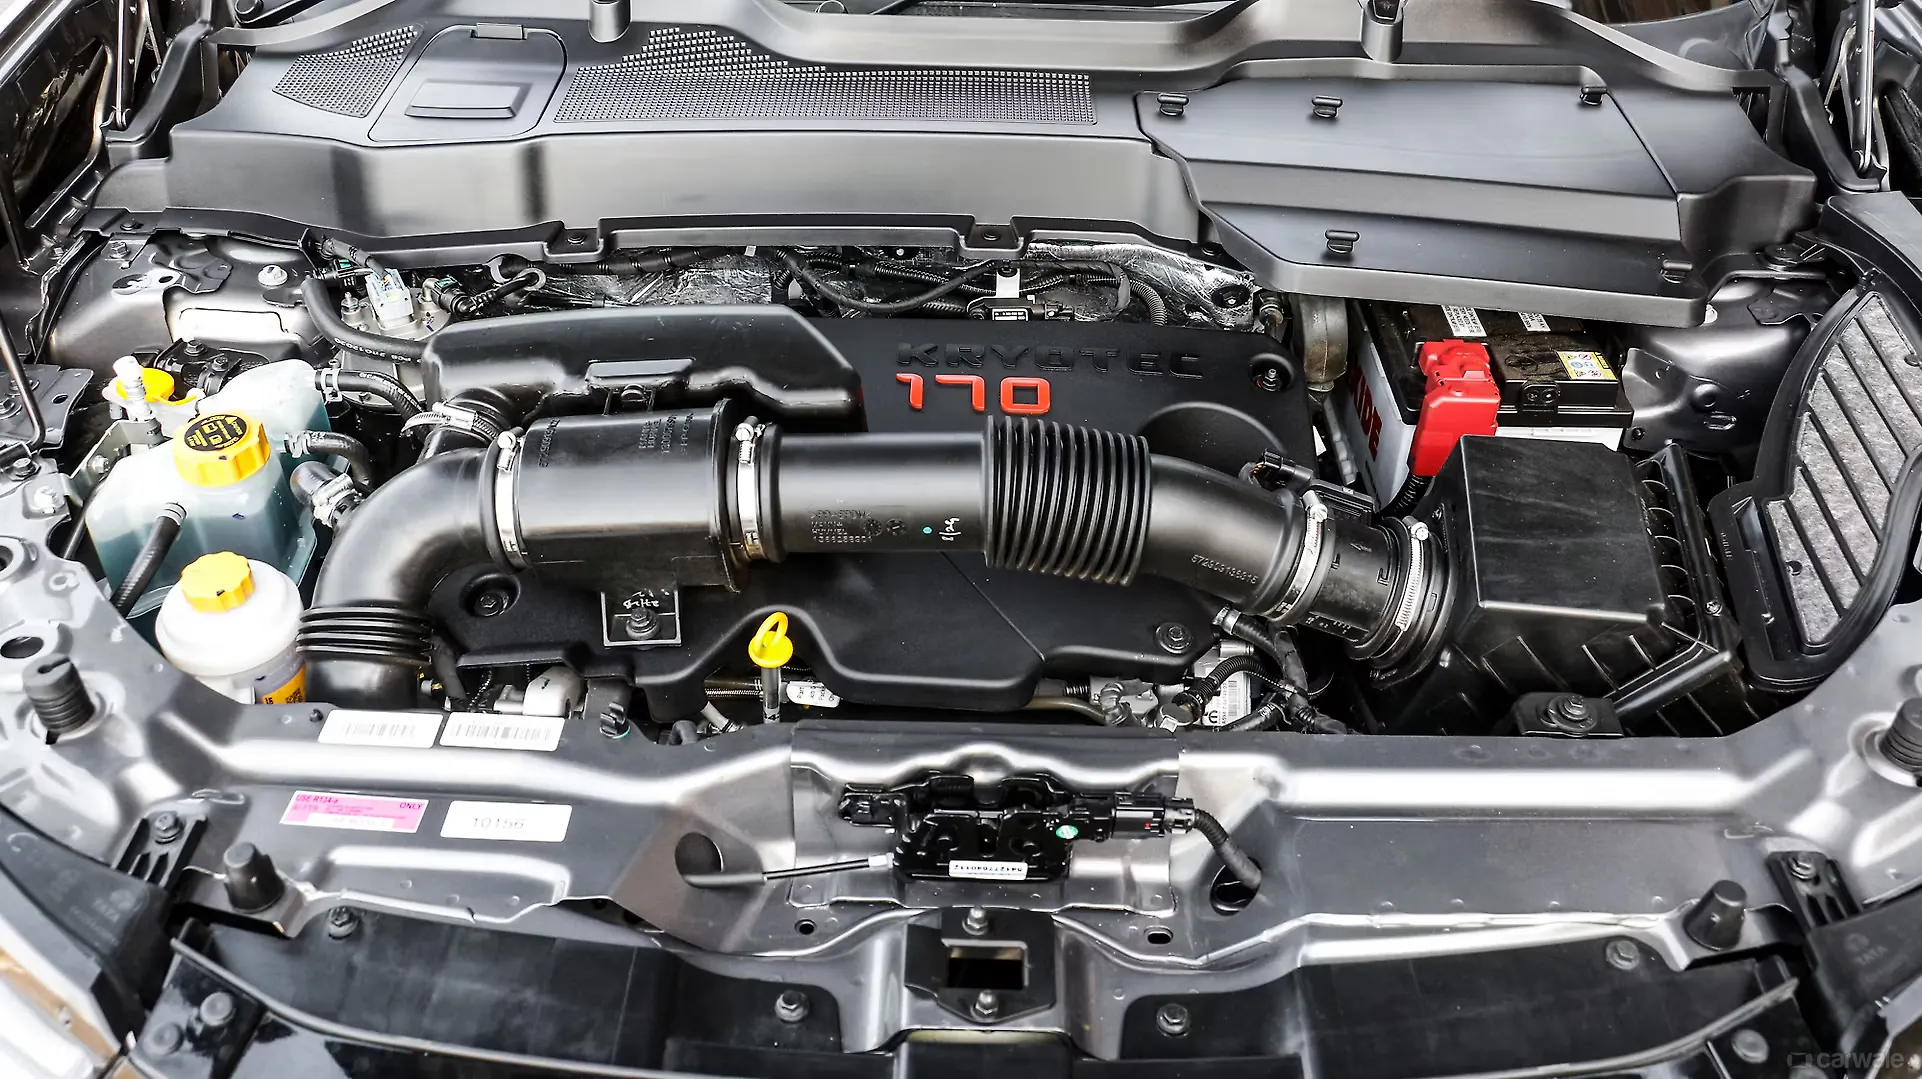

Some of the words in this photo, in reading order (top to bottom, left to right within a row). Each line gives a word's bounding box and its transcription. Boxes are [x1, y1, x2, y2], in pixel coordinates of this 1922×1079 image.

[896, 342, 1204, 380] KRYOTEC
[896, 373, 1051, 415] 170
[296, 794, 311, 802] USE
[399, 801, 423, 810] ONLY
[472, 816, 525, 830] 10156
